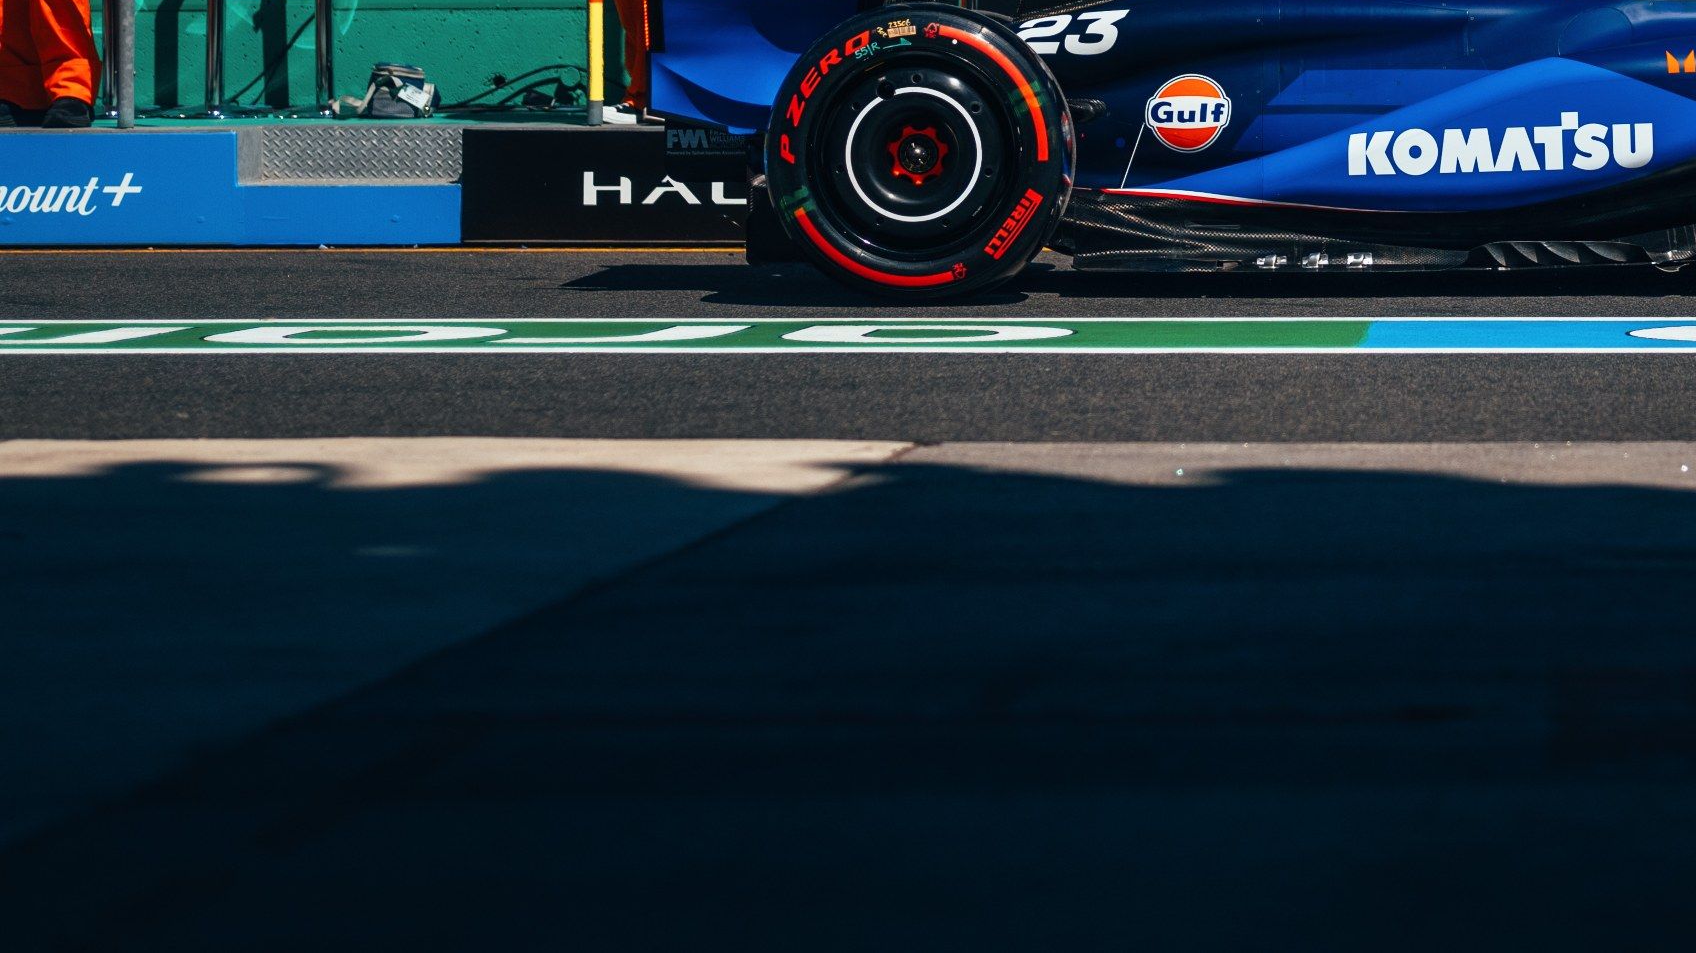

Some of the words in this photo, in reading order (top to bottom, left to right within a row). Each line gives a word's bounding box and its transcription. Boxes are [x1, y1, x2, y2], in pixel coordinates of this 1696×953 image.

[1017, 10, 1129, 55] 23
[786, 30, 871, 129] ZERO
[1150, 101, 1226, 125] Gulf
[779, 135, 797, 165] P
[1347, 111, 1655, 177] KOMATSU
[582, 171, 747, 205] HAL
[984, 188, 1043, 261] PIRELLI
